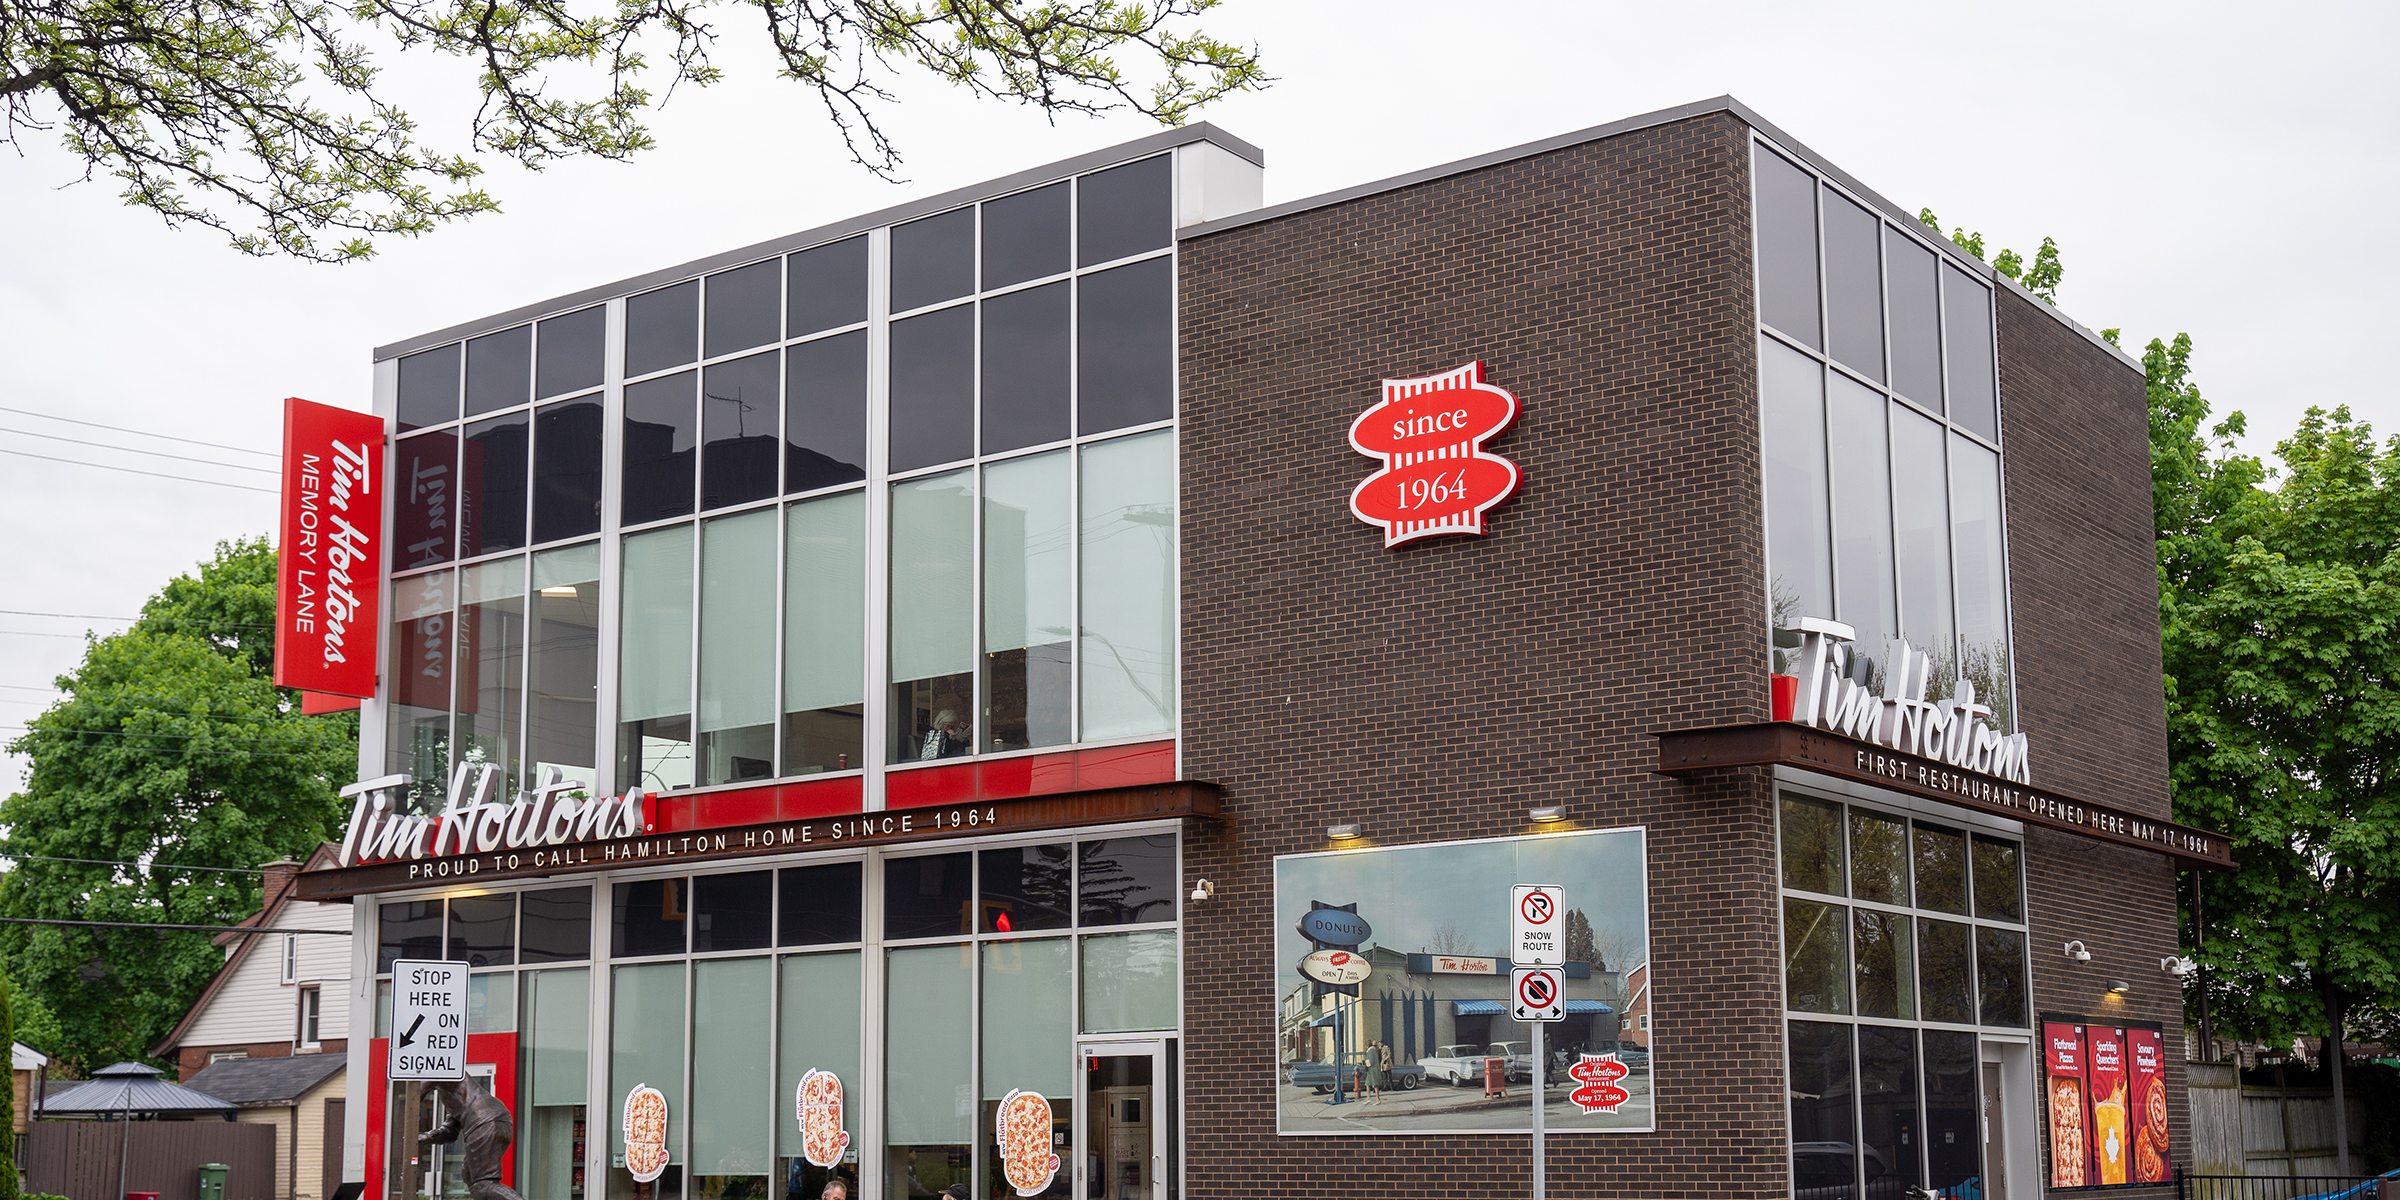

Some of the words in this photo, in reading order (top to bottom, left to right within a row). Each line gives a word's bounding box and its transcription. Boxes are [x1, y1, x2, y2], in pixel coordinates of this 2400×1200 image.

[1393, 409, 1468, 440] since
[328, 439, 370, 511] Tim
[1396, 468, 1467, 510] 1964
[300, 454, 320, 564] MEMORY
[324, 514, 370, 664] Hortons
[296, 569, 316, 634] LANE
[1787, 616, 1885, 745] Tim
[1880, 637, 2031, 785] Hortons
[1857, 750, 1908, 779] FIRST
[1918, 766, 2020, 809] RESTAURANT
[2029, 795, 2084, 826] OPENED
[2092, 811, 2125, 834] HERE
[2132, 820, 2155, 842] MAY
[2163, 829, 2176, 849] 17,
[2183, 834, 2209, 856] 1964
[338, 773, 437, 868] Tim
[434, 761, 645, 856] Hortons
[410, 859, 480, 879] PROUD
[494, 854, 519, 871] TO
[535, 847, 588, 868] CALL
[605, 832, 726, 861] HAMILTON
[745, 825, 812, 847] HOME
[832, 815, 913, 840] SINCE
[934, 807, 997, 829] 1964
[1315, 920, 1363, 935] DONUTS
[1524, 931, 1552, 940] SNOW
[1522, 943, 1553, 951] ROUTE
[1440, 958, 1458, 971] Tim
[1460, 959, 1488, 972] Horton
[411, 971, 451, 985] STOP
[1337, 968, 1344, 982] 7
[410, 992, 451, 1006] HERE
[439, 1014, 459, 1028] ON
[428, 1035, 458, 1049] RED
[2054, 1038, 2076, 1050] Flatbread
[2096, 1040, 2117, 1055] Sparkling
[2137, 1042, 2155, 1057] Savoury
[400, 1056, 455, 1071] SIGNAL
[2059, 1052, 2074, 1063] Pizzas
[2137, 1055, 2157, 1067] Pinwheels
[1577, 1066, 1591, 1077] Tim
[1592, 1066, 1621, 1077] Hortons
[1578, 1095, 1592, 1103] May
